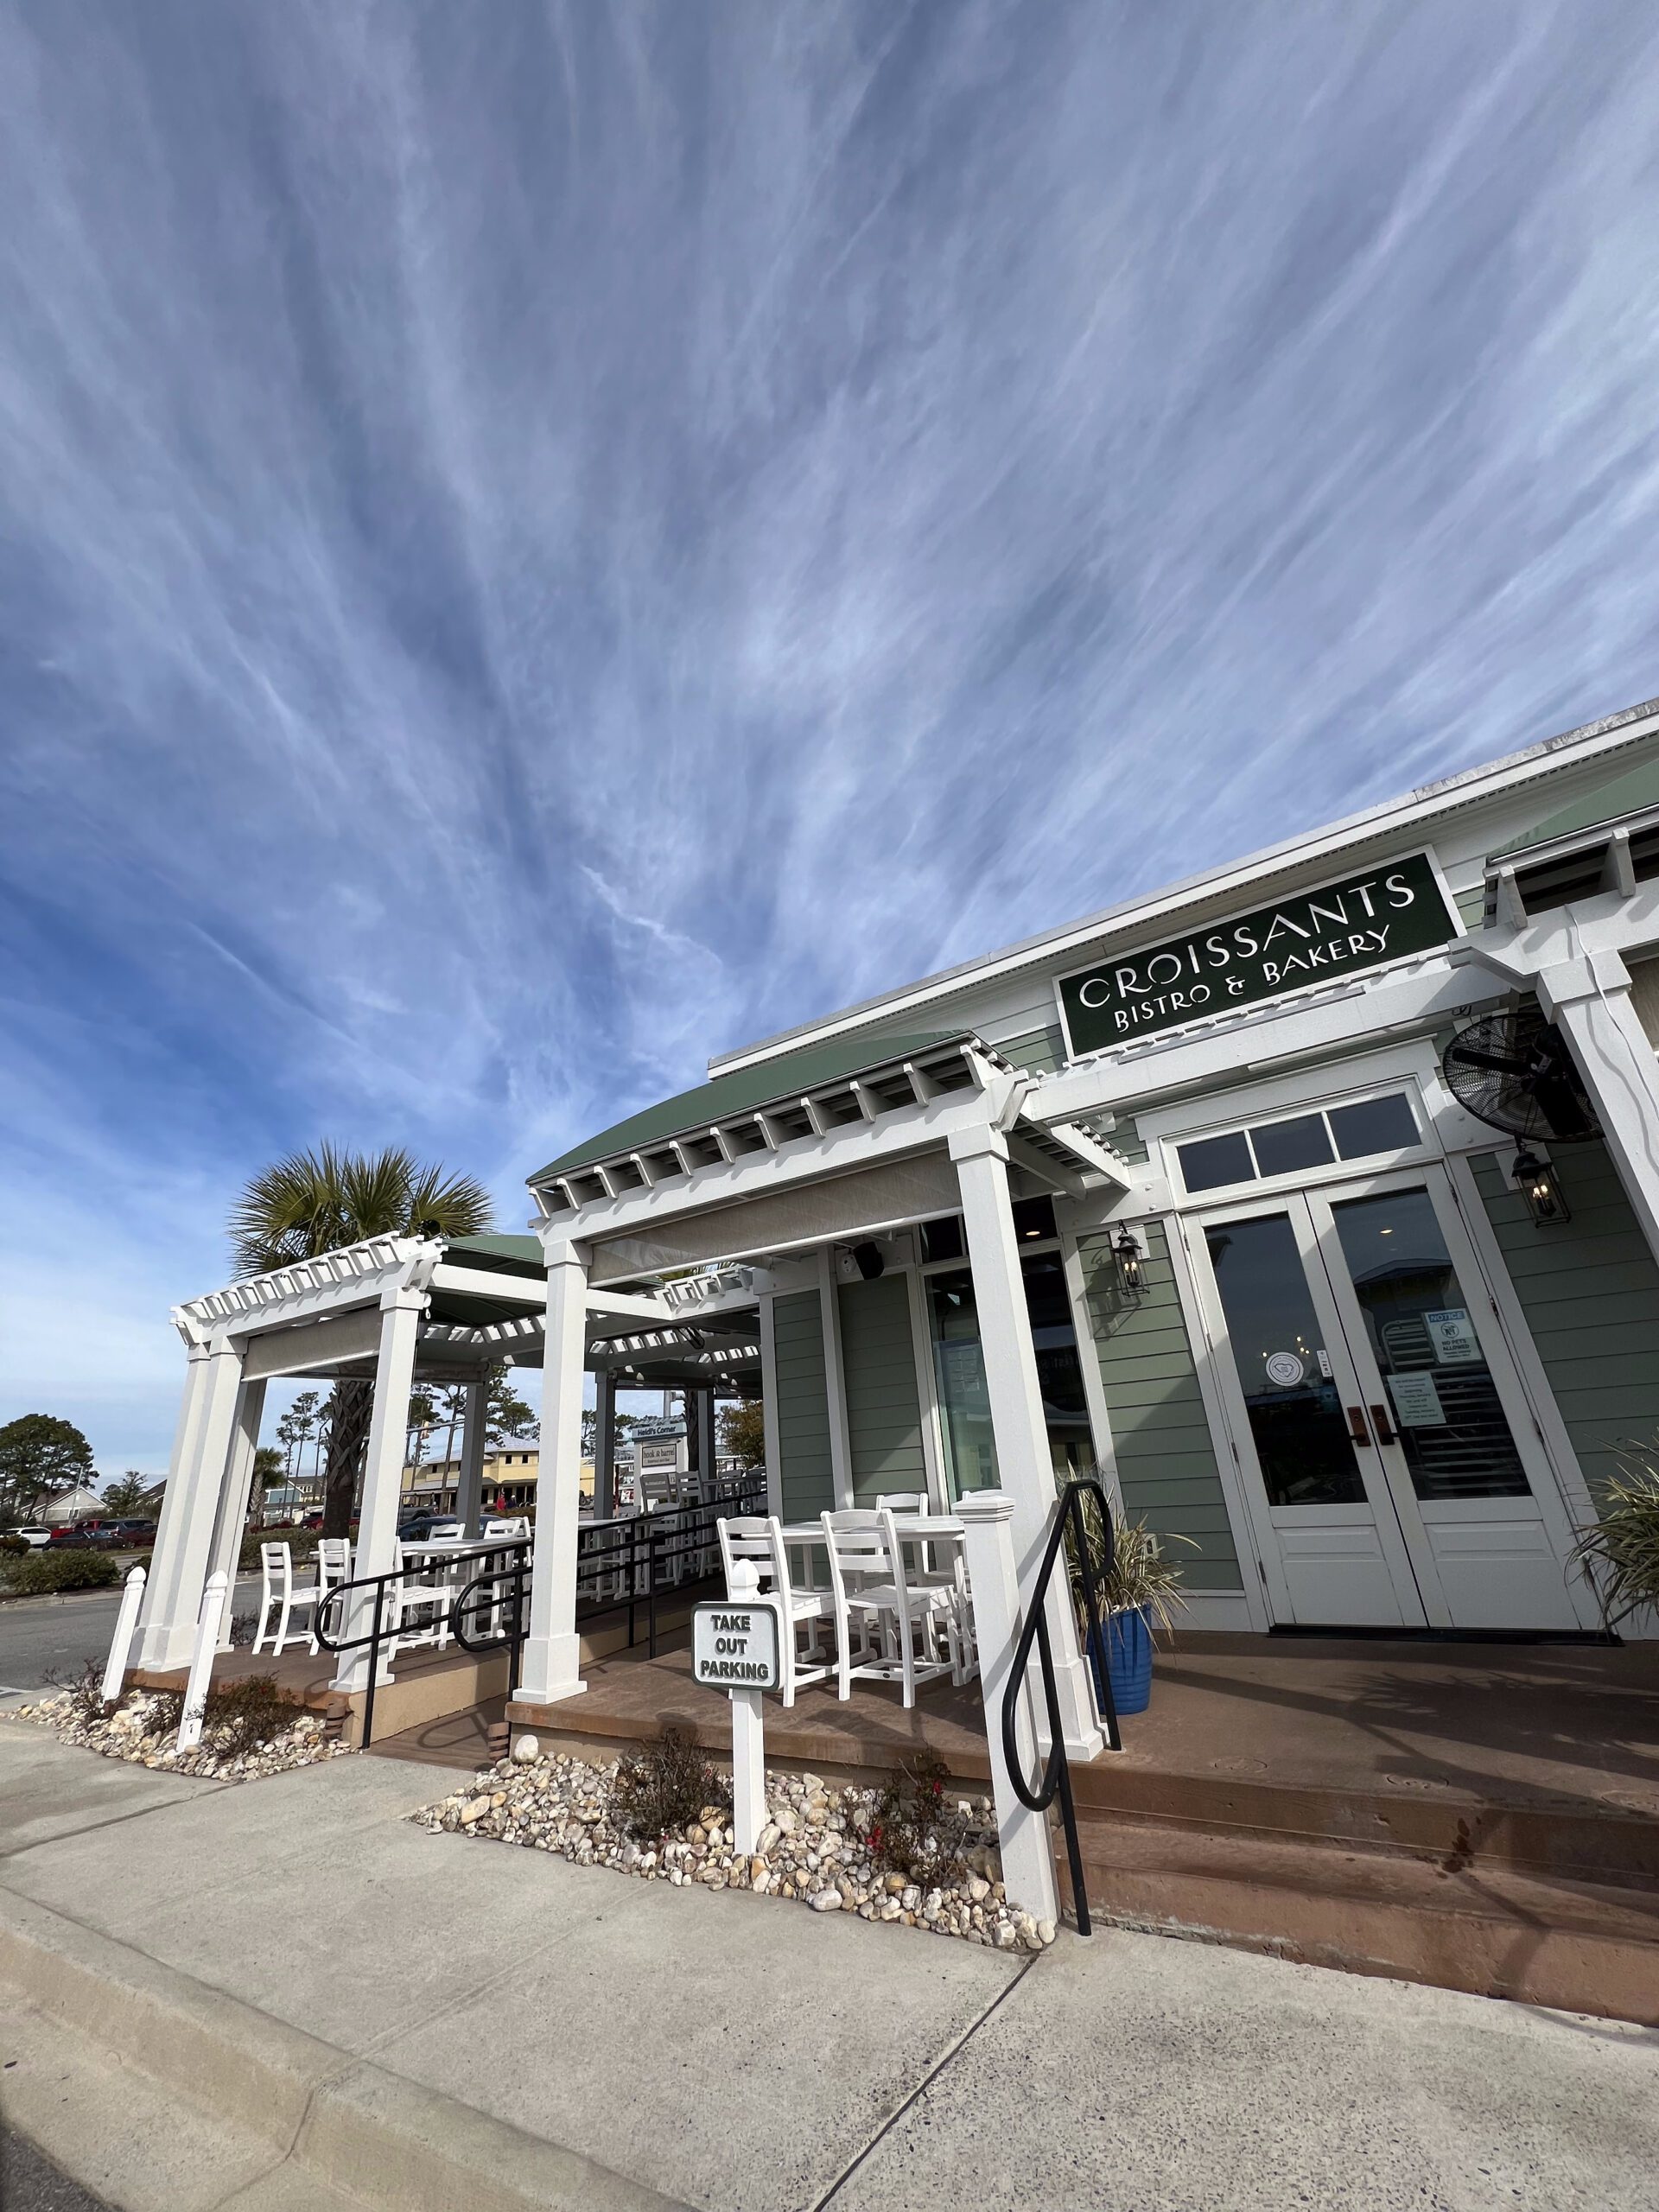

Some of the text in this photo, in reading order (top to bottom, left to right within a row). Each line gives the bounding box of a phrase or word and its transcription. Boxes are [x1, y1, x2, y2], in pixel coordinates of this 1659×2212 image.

[1078, 874, 1415, 1008] CROISSANTS
[1114, 924, 1392, 1033] BISTRO & BAKERY
[1430, 1312, 1463, 1321] NOTICE
[710, 1615, 751, 1631] TAKE
[715, 1637, 747, 1655] OUT
[701, 1660, 768, 1681] PARKING
